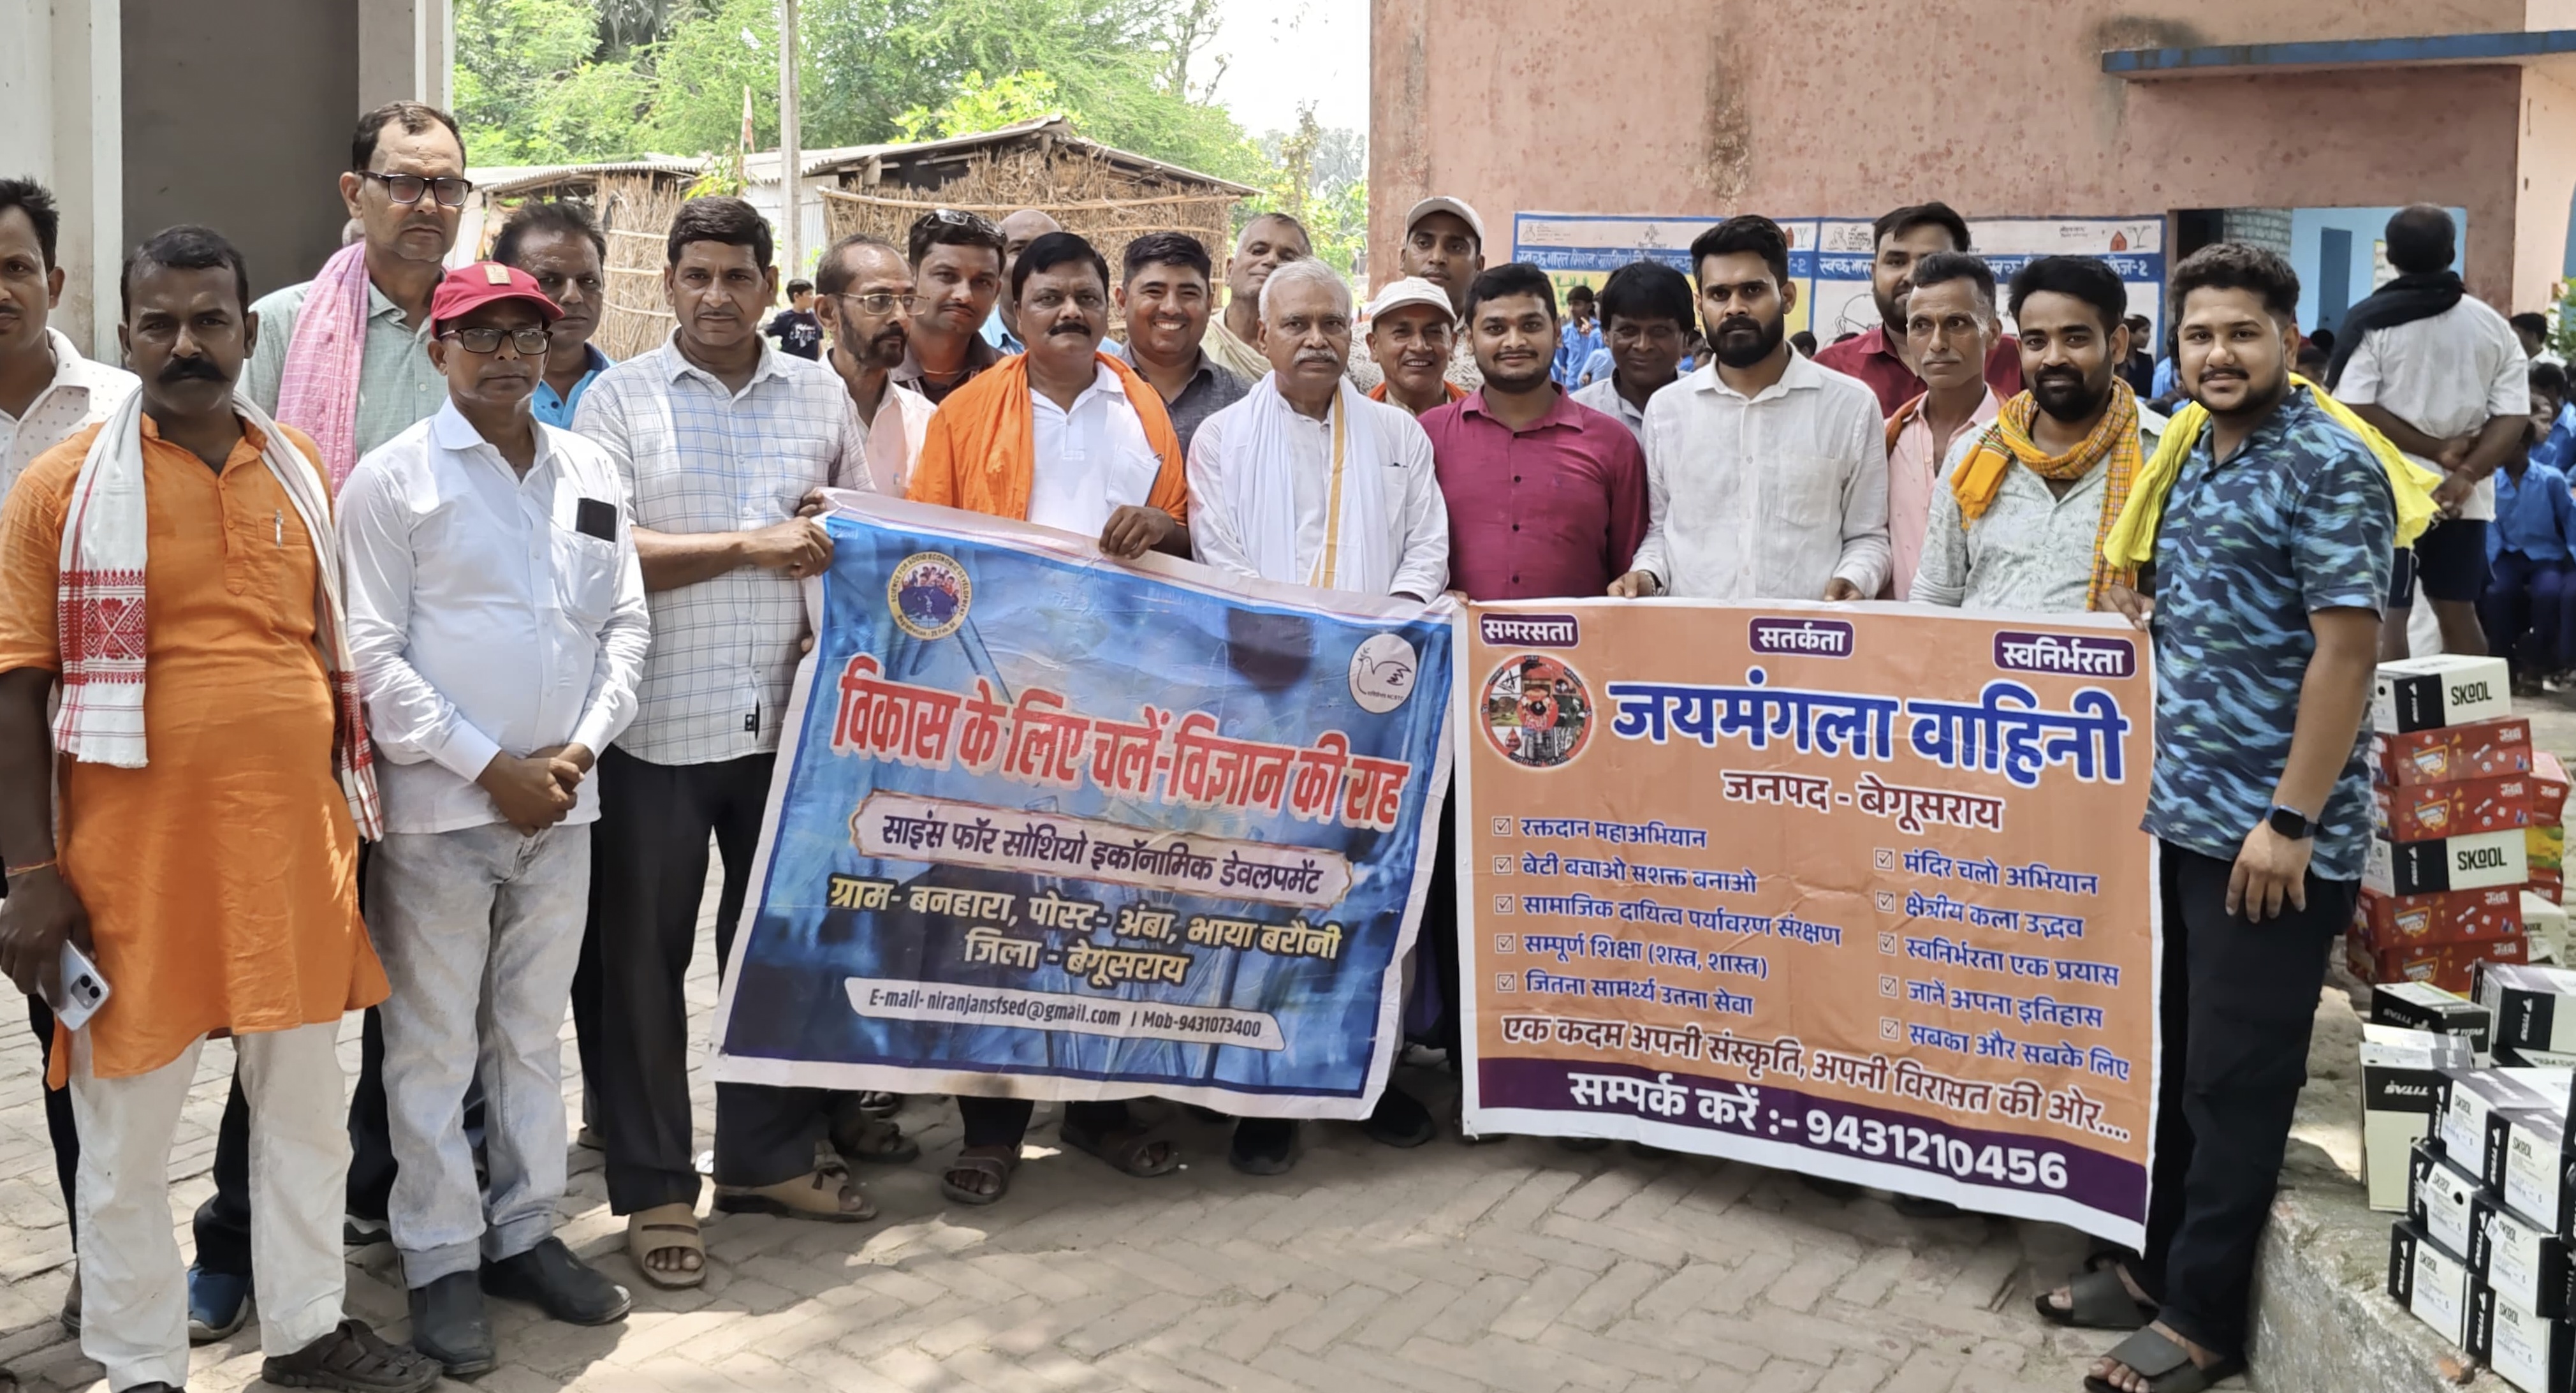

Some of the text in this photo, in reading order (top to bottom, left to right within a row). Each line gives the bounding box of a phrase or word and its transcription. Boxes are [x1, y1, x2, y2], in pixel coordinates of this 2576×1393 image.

[898, 563, 908, 573] FOR
[1483, 620, 1574, 641] समरसता
[1757, 622, 1846, 652] सतर्कता
[2002, 637, 2124, 674] स्वनिर्भरता
[2451, 681, 2492, 706] SKOOL
[833, 654, 1409, 825] विकास के लिए चलें-विज्ञान की राह
[1608, 668, 2127, 785] जयमंगला वाहिनी
[1722, 772, 1829, 810] जनपद
[1857, 776, 2002, 830] बेगूसराय
[882, 809, 1323, 894] साइंस फॉर सोशियो इकॉनामिक डेवलपमेंट
[1520, 819, 1706, 848] रक्तदान महाअभियान
[1522, 852, 1757, 893] बेटी बचाओ सशक्त बनाओ
[1903, 849, 2098, 894] मंदिर चलो अभियान
[2457, 846, 2507, 871] SKOOL
[830, 877, 1343, 959] ग्राम- बनहारा, पोस्ट- अंबा, भाया बरौनी
[1523, 893, 1841, 946] सामाजिक दायित्व पर्यावरण संरक्षण
[1905, 892, 1963, 922] क्षेत्रीय
[1970, 904, 2019, 930] कला
[964, 927, 1043, 969] जिला
[1067, 939, 1190, 986] बेगूसराय
[1523, 932, 1768, 980] सम्पूर्ण शिक्षा (शस्त्र, शास्त्र)
[1905, 937, 2120, 987] स्वनिर्भरता एक प्रयास
[869, 988, 924, 1008] E-mail-
[927, 991, 1121, 1026] niranjansfsed@gmail.com
[1142, 1011, 1261, 1037] Mob-9431073400
[1525, 969, 1753, 1015] जितना सामर्थ्य उतना सेवा
[1908, 979, 2103, 1028] जानें अपना इतिहास
[2521, 1013, 2529, 1042] TITAS
[1502, 1017, 1551, 1042] एक
[1556, 1018, 1626, 1047] कदम
[1630, 1026, 1702, 1058] अपनी
[1708, 1030, 1805, 1078] संस्कृति,
[1812, 1056, 1888, 1090] अपनी
[1894, 1062, 1990, 1111] विरासत
[1999, 1081, 2041, 1117] की
[1908, 1024, 2130, 1080] सबका और सबके लिए
[2384, 1084, 2429, 1096] TITAS
[1568, 1072, 1689, 1116] सम्पर्क
[1695, 1083, 1759, 1131] करें
[1806, 1109, 2068, 1190] 9431210456
